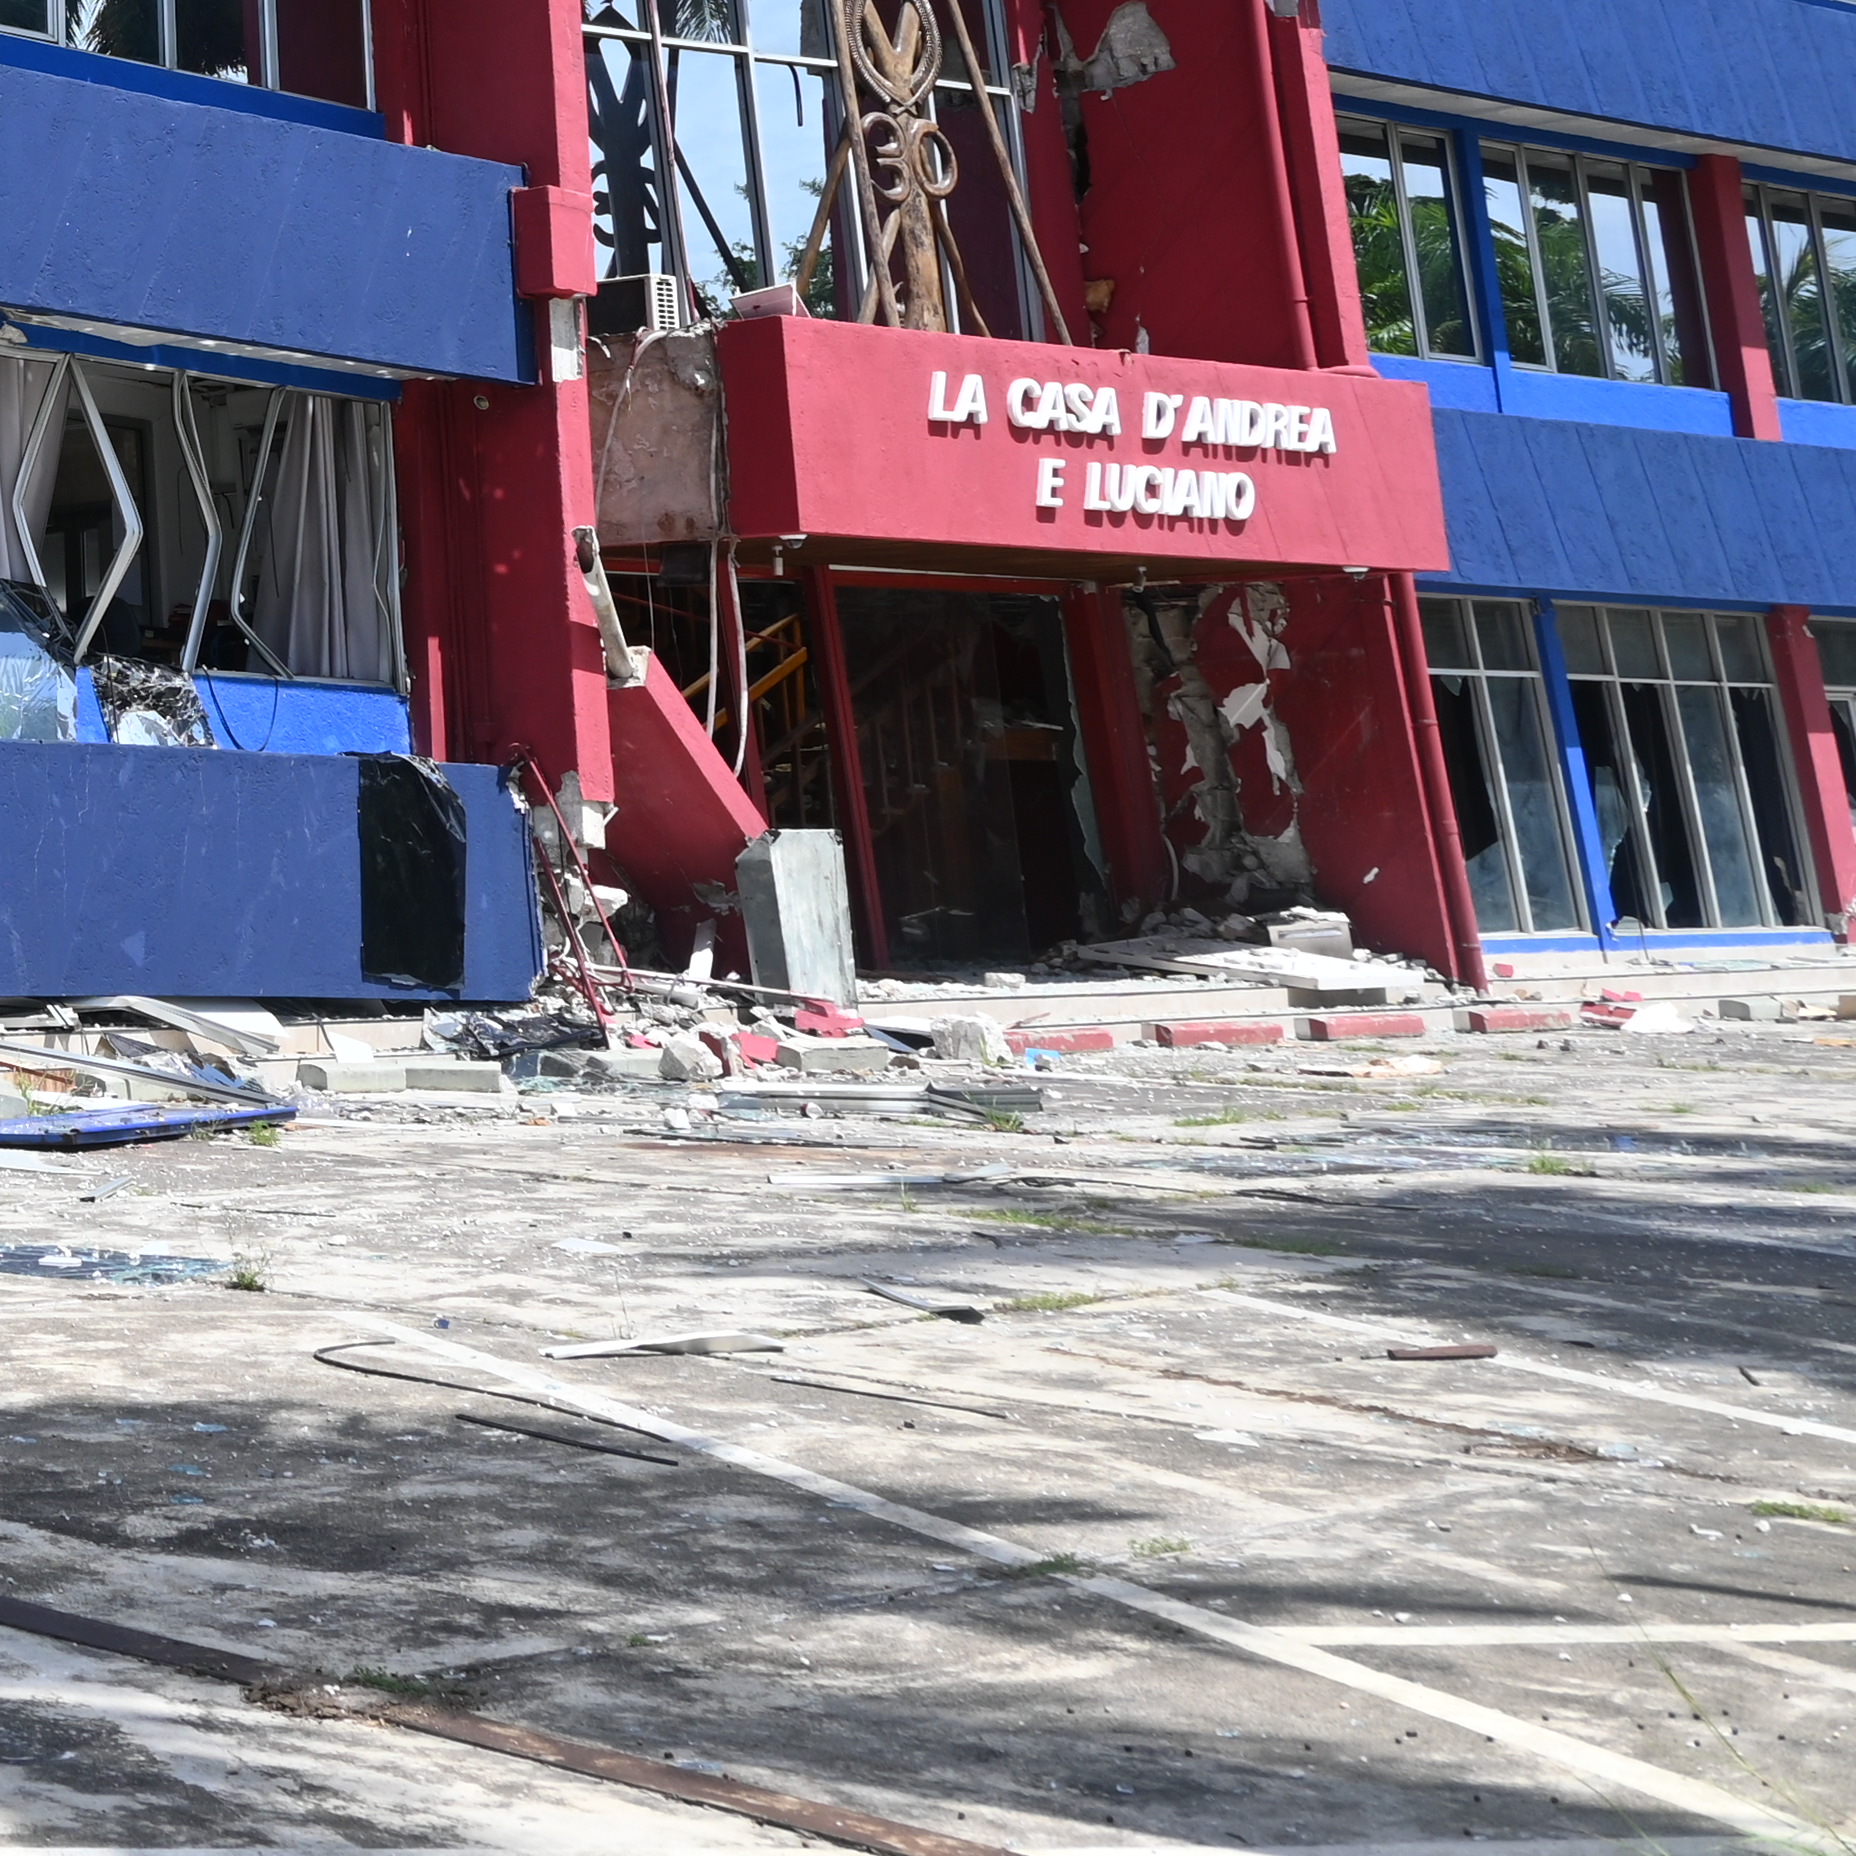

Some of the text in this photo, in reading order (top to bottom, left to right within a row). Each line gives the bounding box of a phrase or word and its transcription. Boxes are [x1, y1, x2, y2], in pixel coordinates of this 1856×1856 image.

[927, 370, 989, 425] LA
[1006, 377, 1123, 436] CASA
[1035, 457, 1256, 521] E LUCIANO
